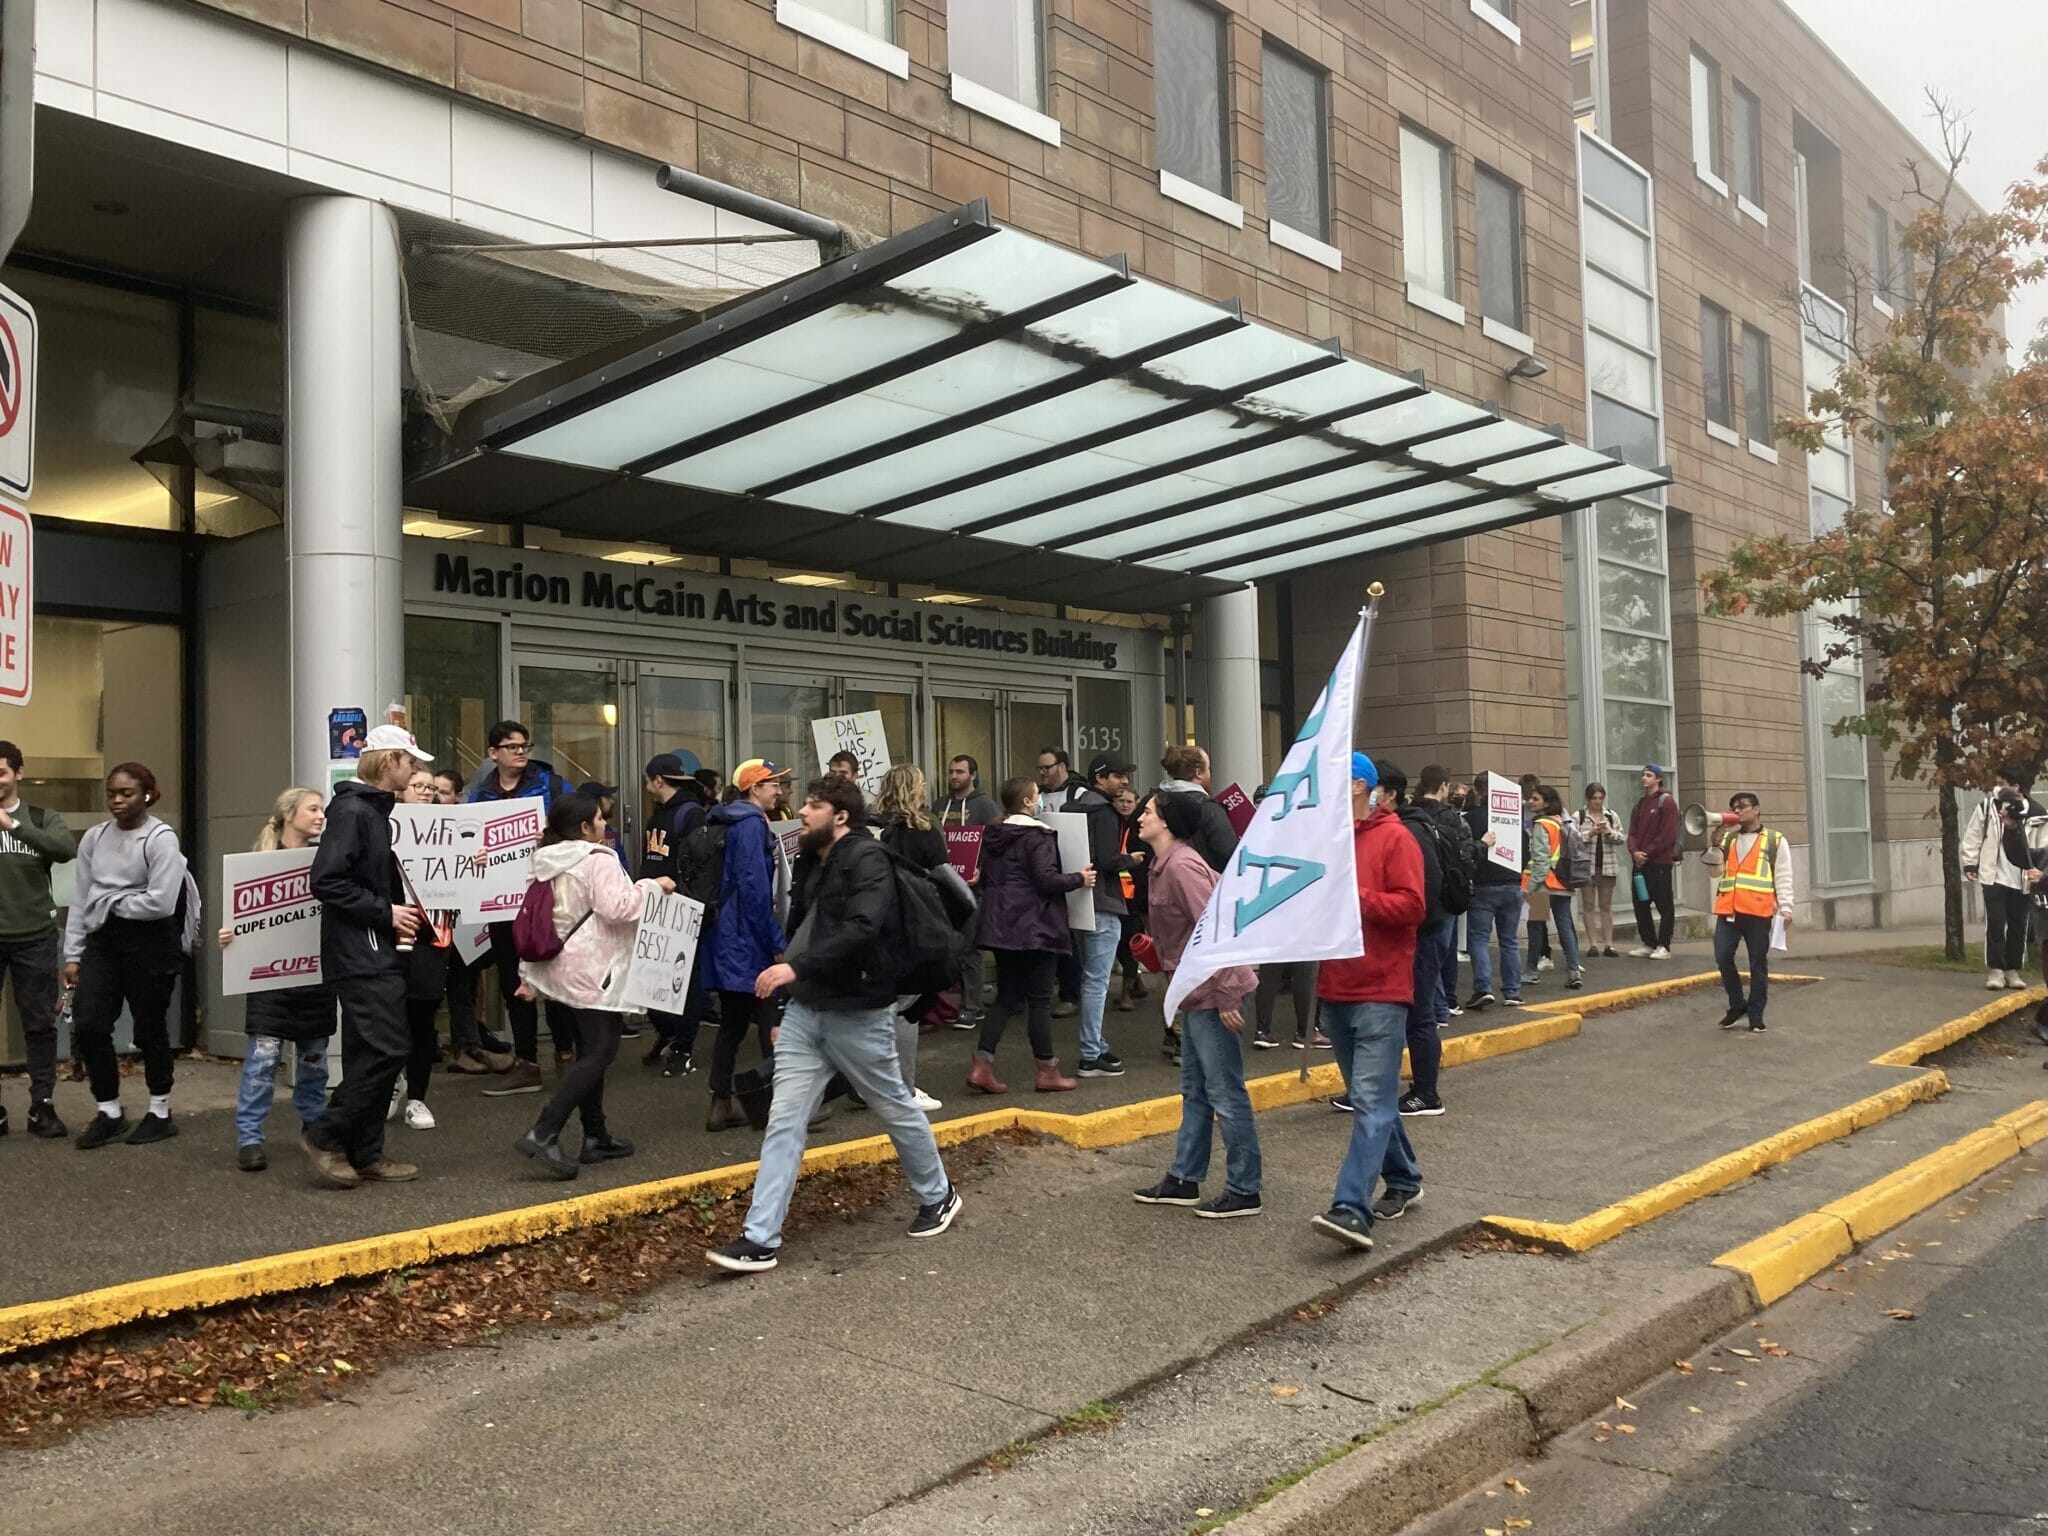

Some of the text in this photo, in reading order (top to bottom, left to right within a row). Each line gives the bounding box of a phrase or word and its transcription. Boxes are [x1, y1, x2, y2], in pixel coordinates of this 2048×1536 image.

[433, 553, 1118, 669] Marion McCain Arts and Social Sciences Building
[835, 718, 866, 738] DAL
[1078, 726, 1121, 752] 6135
[839, 737, 867, 756] HAS
[410, 817, 456, 846] WiFi
[488, 816, 538, 846] STRIKE
[948, 831, 980, 842] WAGES
[422, 857, 448, 882] TA
[489, 852, 517, 867] LOCAL
[238, 873, 311, 911] ON STRI
[494, 892, 525, 906] CUP
[234, 904, 322, 936] CUPE LOCAL 39
[643, 891, 670, 929] DAL
[671, 903, 686, 932] IS
[269, 956, 320, 973] CUPE
